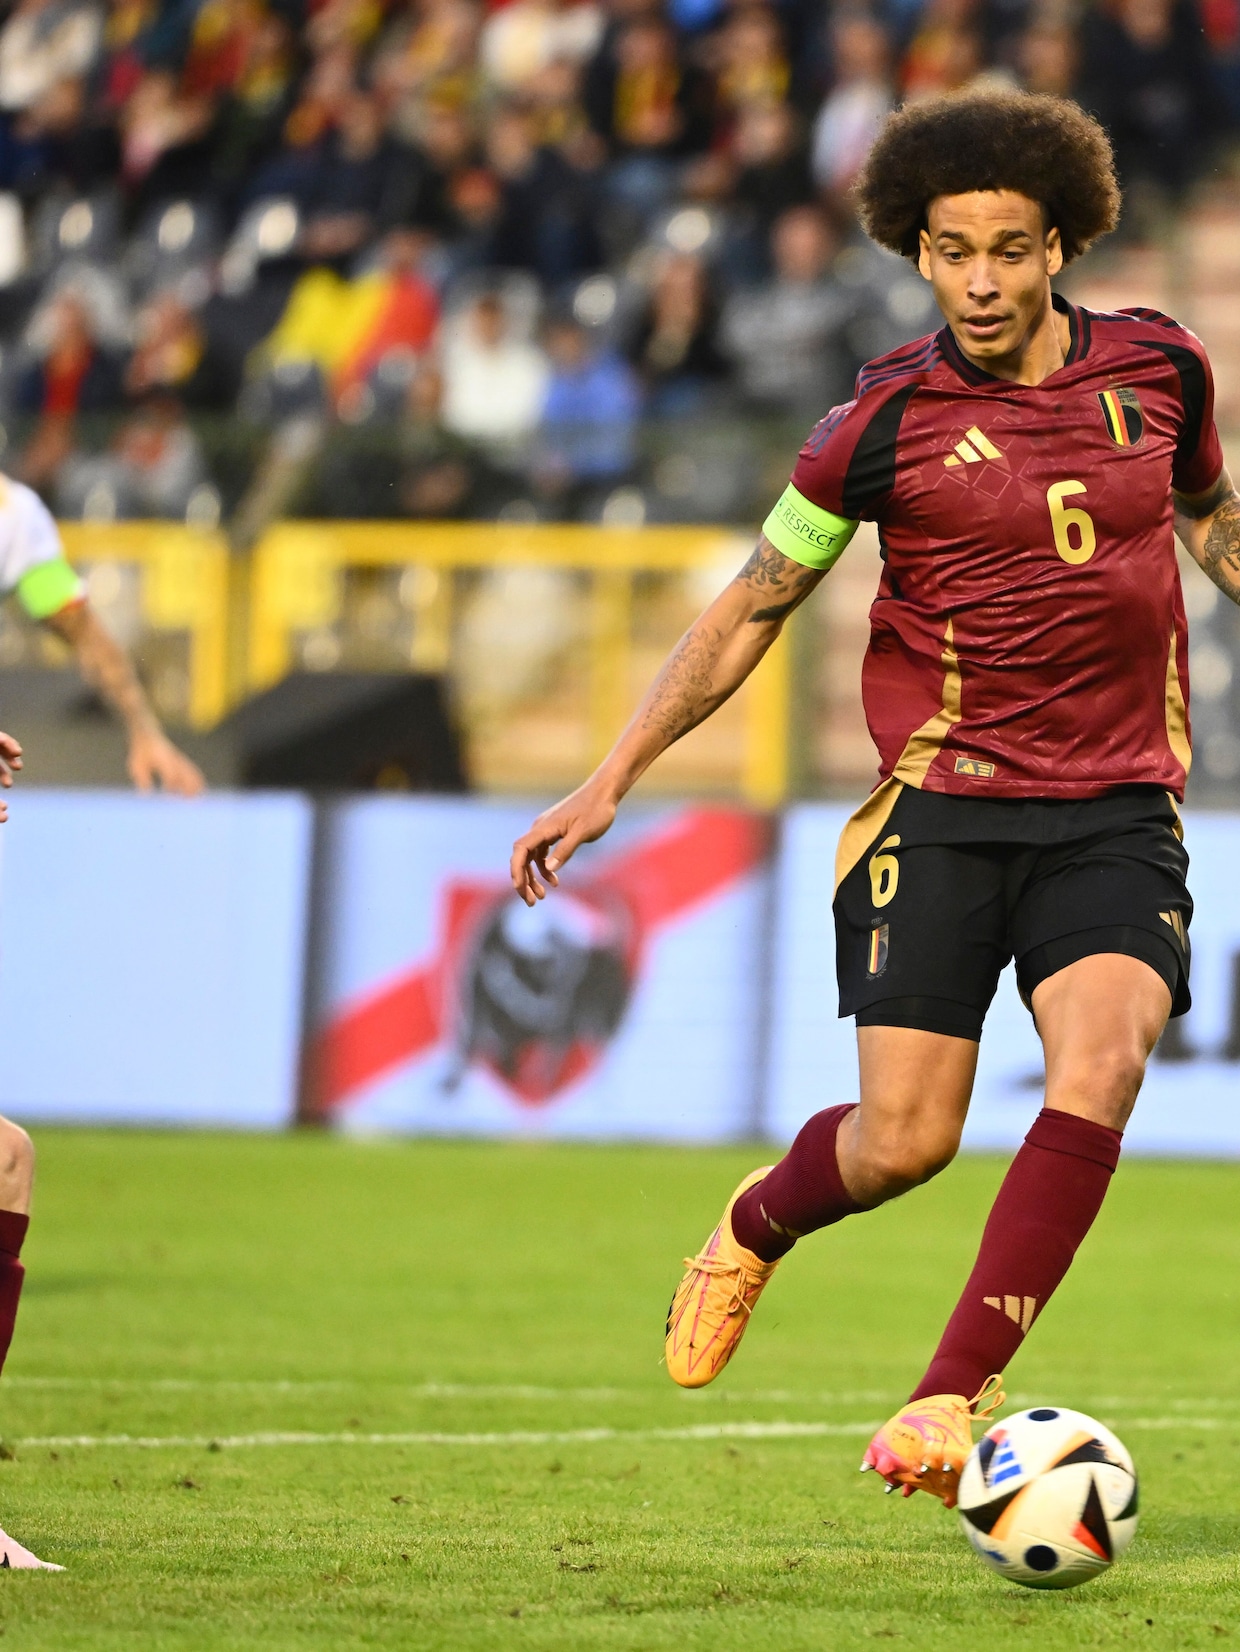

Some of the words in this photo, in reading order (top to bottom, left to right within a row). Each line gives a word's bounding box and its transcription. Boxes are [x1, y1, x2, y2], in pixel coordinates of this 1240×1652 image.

[782, 507, 837, 548] RESPECT
[1046, 479, 1097, 565] 6
[867, 833, 902, 909] 6
